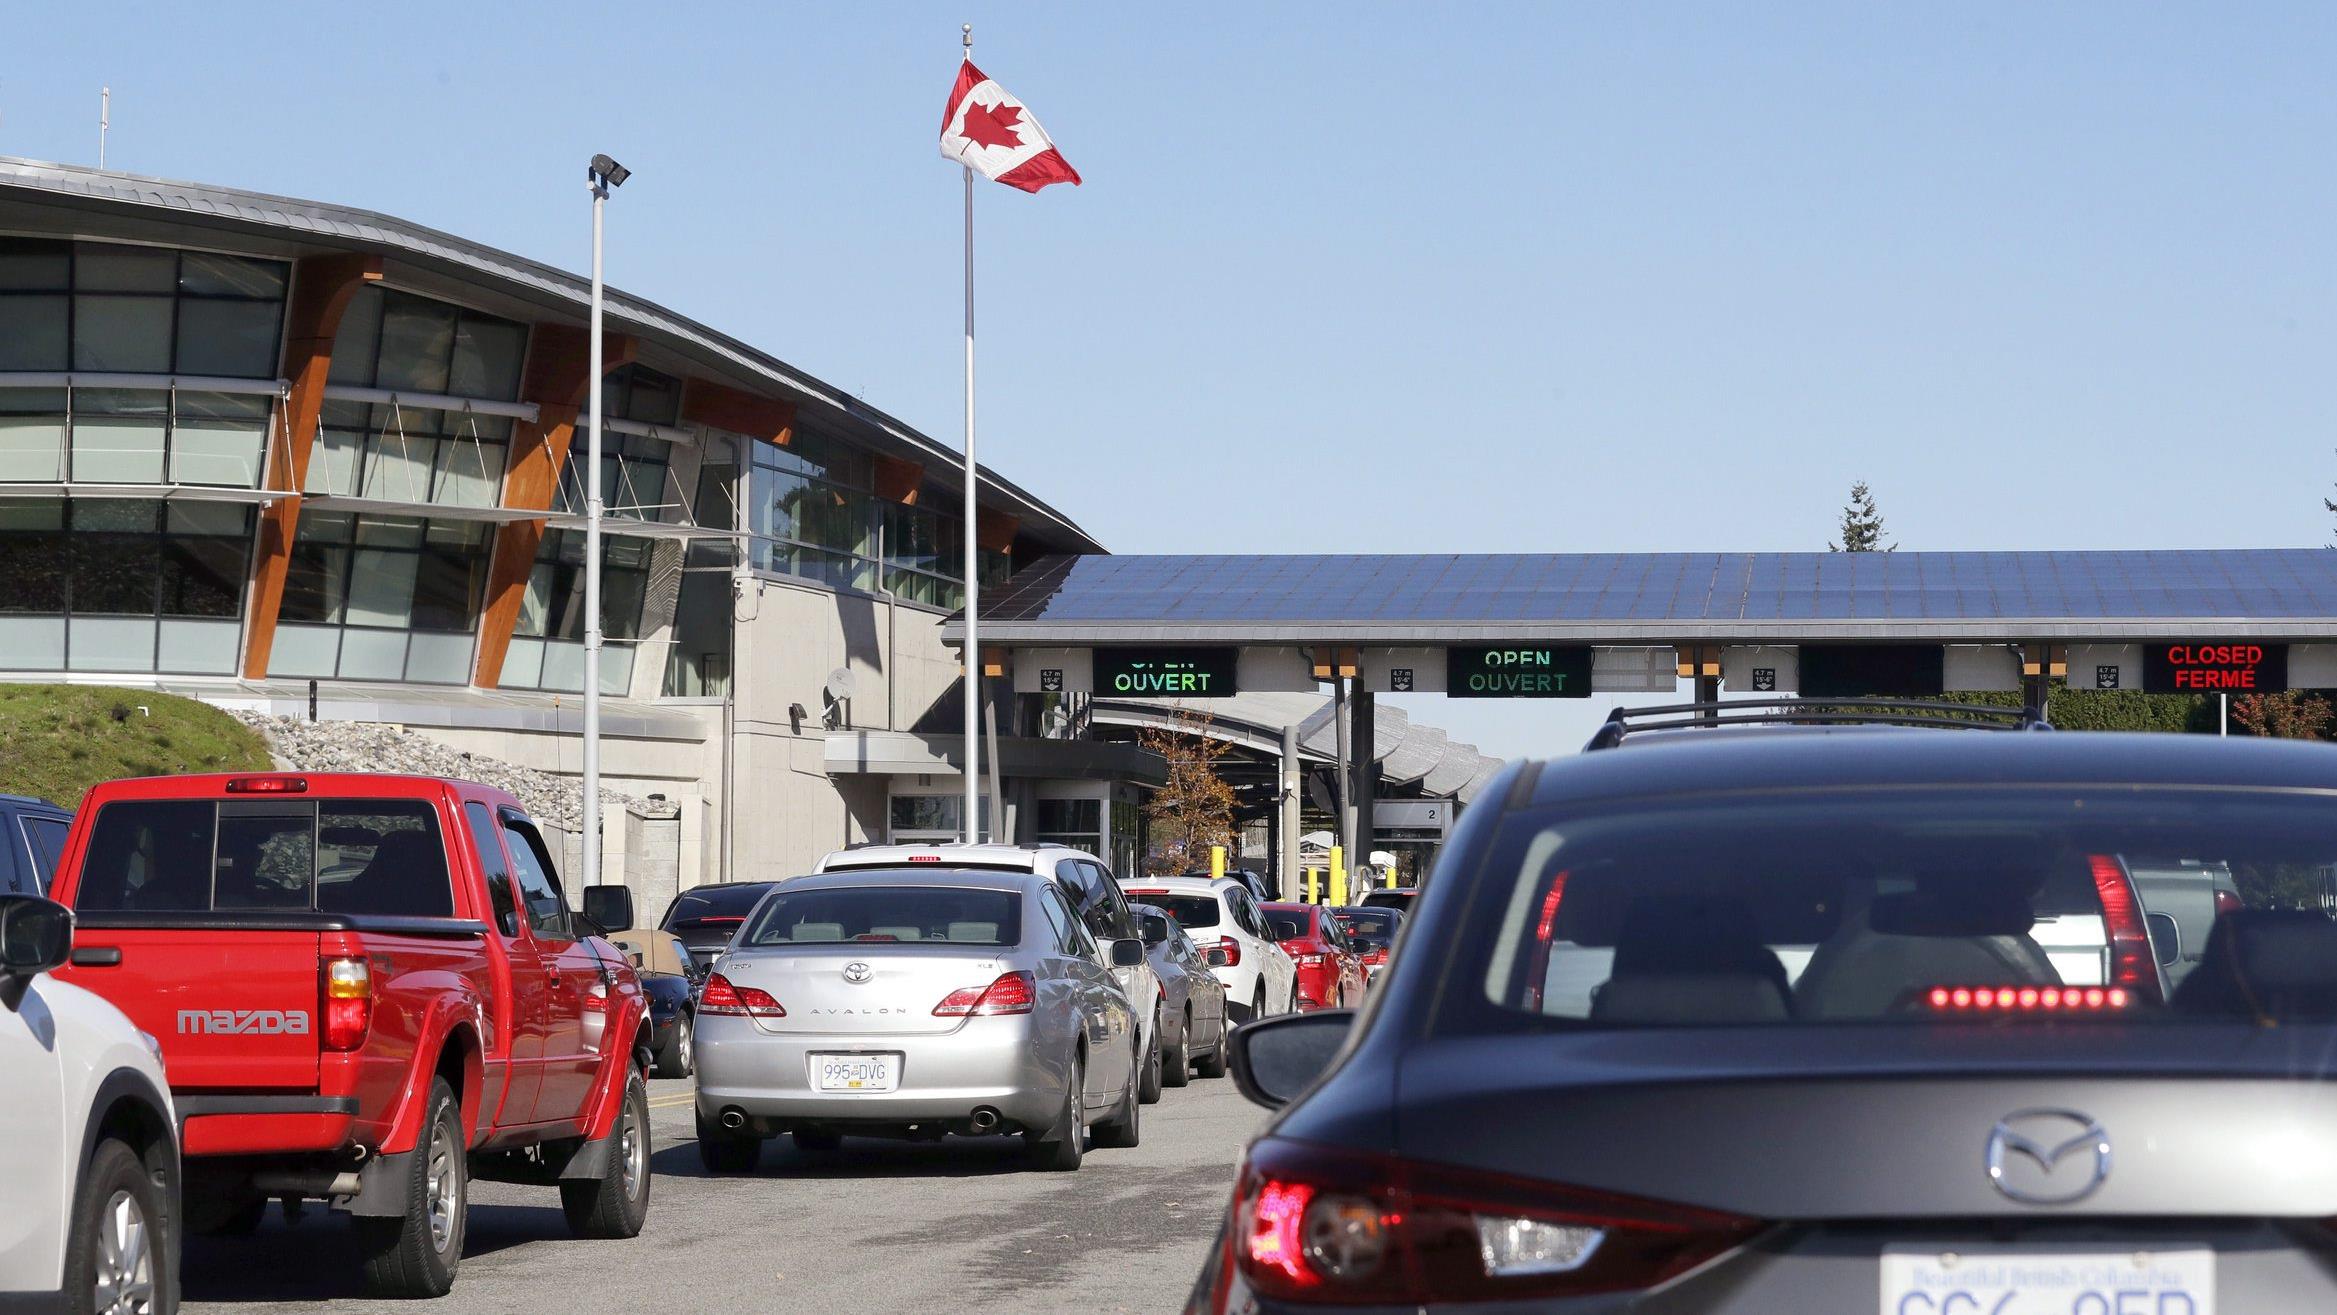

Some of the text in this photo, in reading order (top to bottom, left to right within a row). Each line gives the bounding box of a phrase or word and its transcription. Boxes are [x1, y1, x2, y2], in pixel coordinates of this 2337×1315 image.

[2168, 646, 2262, 664] CLOSED
[1115, 673, 1211, 691] OUVERT
[1469, 673, 1567, 691] OUVERT
[2175, 665, 2256, 688] FERMÉ
[1428, 810, 1436, 819] 2
[177, 1010, 309, 1034] mazda
[824, 1064, 885, 1080] 995 DVG
